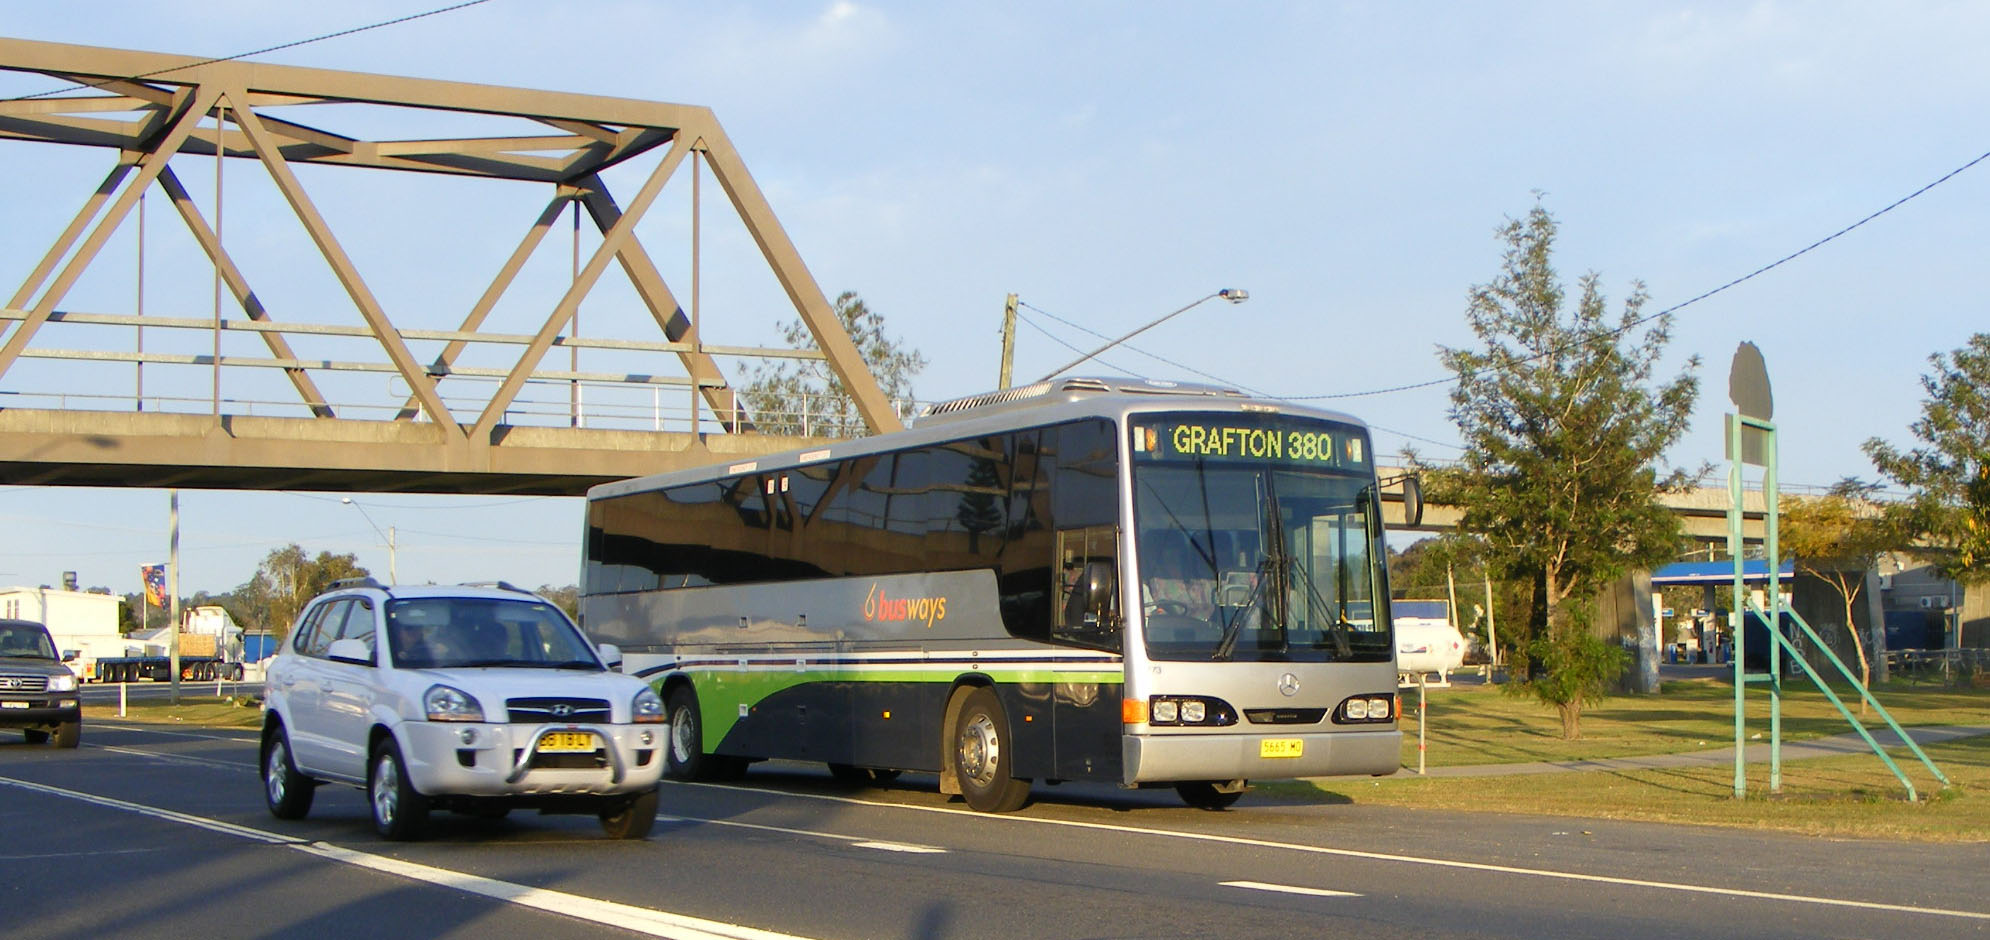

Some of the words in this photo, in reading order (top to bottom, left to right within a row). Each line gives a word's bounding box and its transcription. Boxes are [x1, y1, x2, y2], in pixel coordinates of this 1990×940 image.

[1173, 425, 1282, 458] GRAFTON
[1288, 432, 1331, 461] 380
[878, 589, 947, 629] busways
